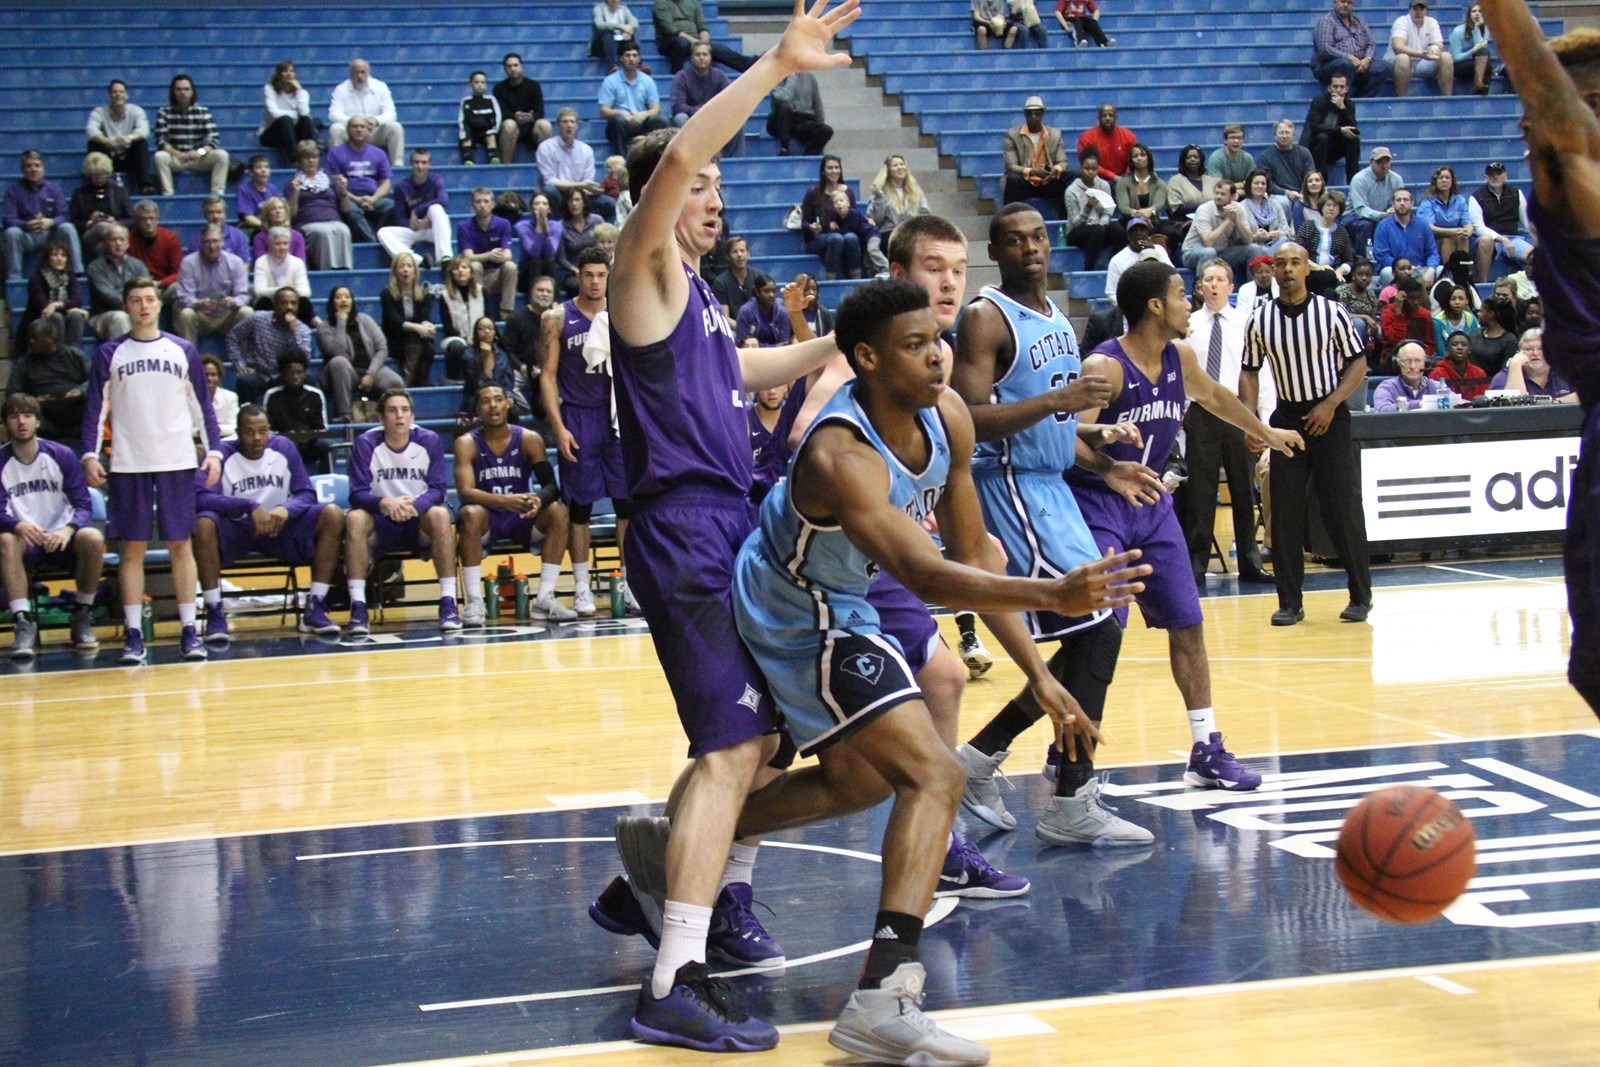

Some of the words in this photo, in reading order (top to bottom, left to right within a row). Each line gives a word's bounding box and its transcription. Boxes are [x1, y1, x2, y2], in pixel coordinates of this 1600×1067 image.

[117, 358, 183, 380] FURMAN
[1117, 400, 1181, 423] FURMAN
[377, 467, 426, 483] FURMAN
[479, 466, 522, 482] FURMAN
[8, 479, 59, 498] FURMAN
[231, 474, 284, 496] FURMAN
[315, 478, 335, 504] C
[856, 657, 876, 677] C
